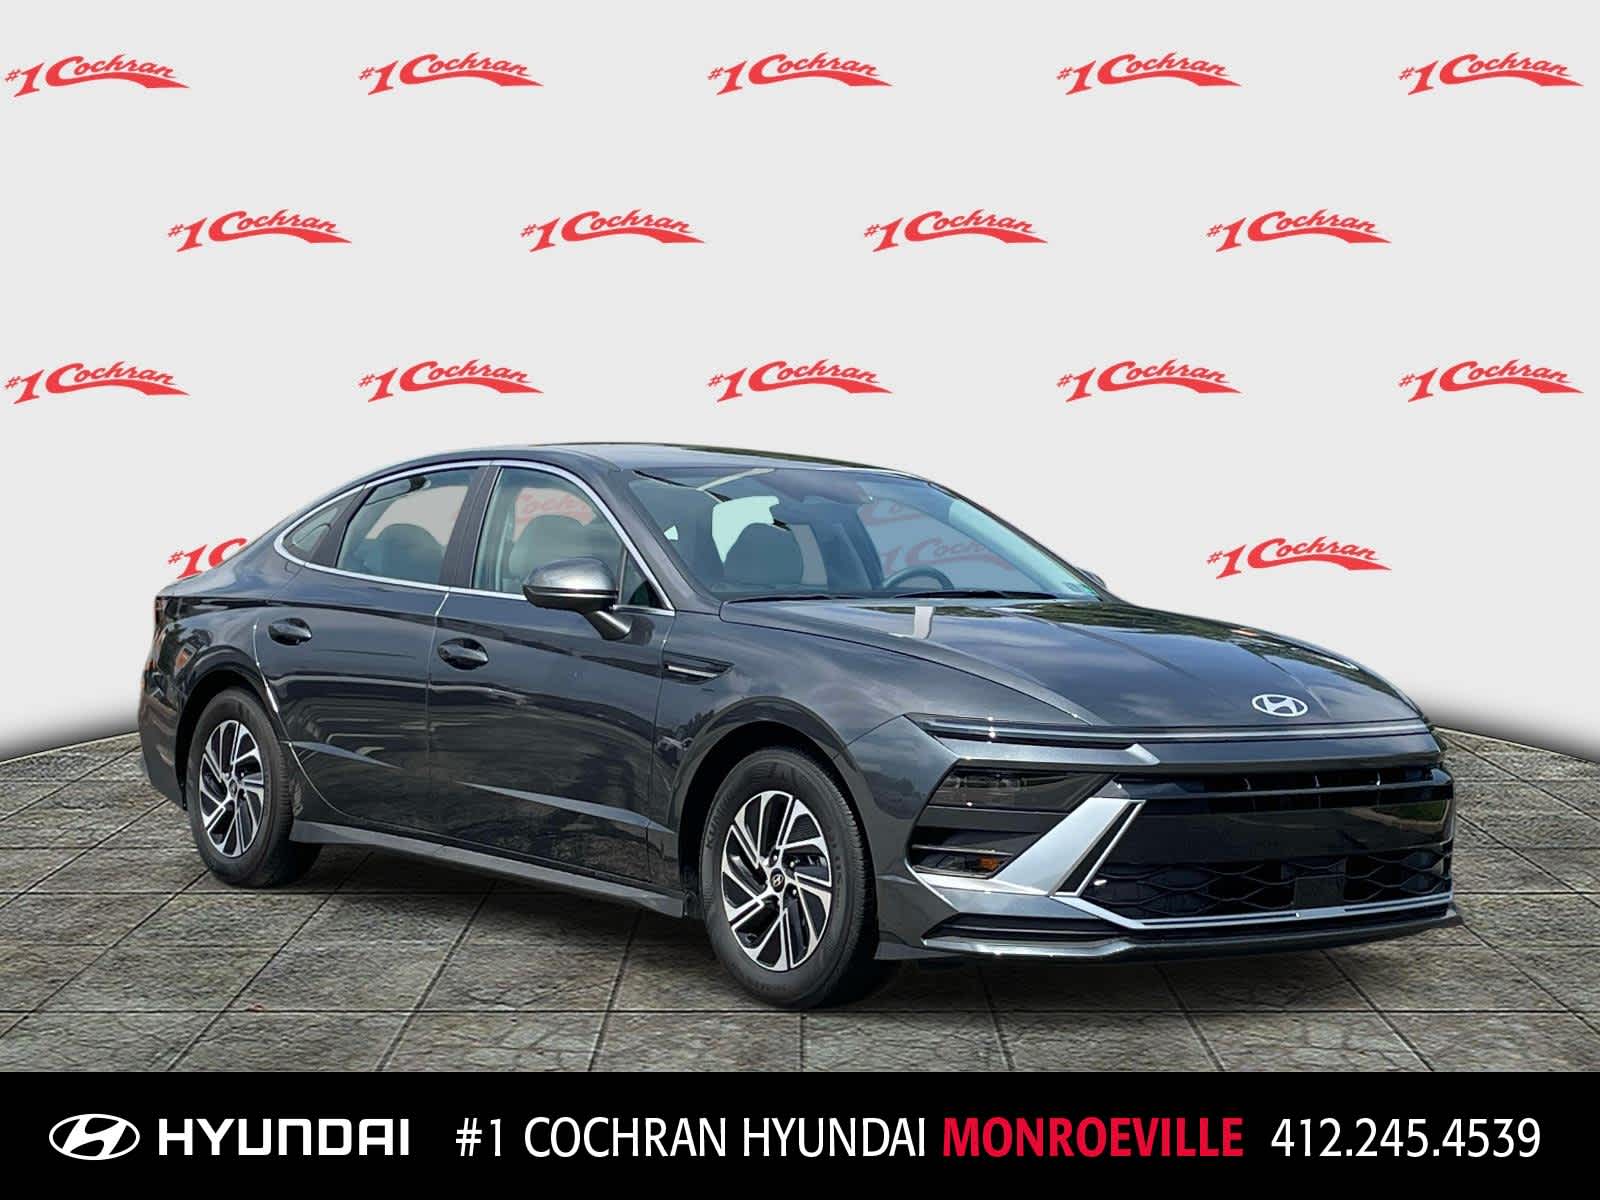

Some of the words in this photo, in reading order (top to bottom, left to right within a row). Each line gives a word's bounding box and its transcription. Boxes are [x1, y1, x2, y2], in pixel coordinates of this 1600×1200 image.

[5, 63, 44, 97] #1
[44, 54, 186, 90] Cochran
[359, 60, 398, 96] #1
[398, 52, 540, 87] Cochran
[709, 61, 747, 96] #1
[747, 52, 888, 88] Cochran
[1057, 60, 1096, 95] #1
[1096, 52, 1238, 87] Cochran
[1399, 60, 1438, 96] #1
[1438, 52, 1580, 87] Cochran
[169, 218, 206, 253] #1
[208, 210, 350, 244] Cochran
[521, 218, 559, 252] #1
[560, 209, 702, 244] Cochran
[864, 218, 903, 252] #1
[903, 209, 1046, 244] Cochran
[1208, 218, 1245, 252] #1
[1247, 209, 1389, 244] Cochran
[5, 369, 43, 404] #1
[44, 361, 186, 396] Cochran
[358, 368, 398, 403] #1
[398, 359, 540, 394] Cochran
[709, 368, 747, 402] #1
[747, 359, 889, 394] Cochran
[1057, 368, 1096, 402] #1
[1096, 359, 1238, 394] Cochran
[1399, 368, 1438, 403] #1
[1438, 359, 1580, 394] Cochran
[1206, 545, 1247, 580] #1
[1246, 536, 1387, 571] Cochran
